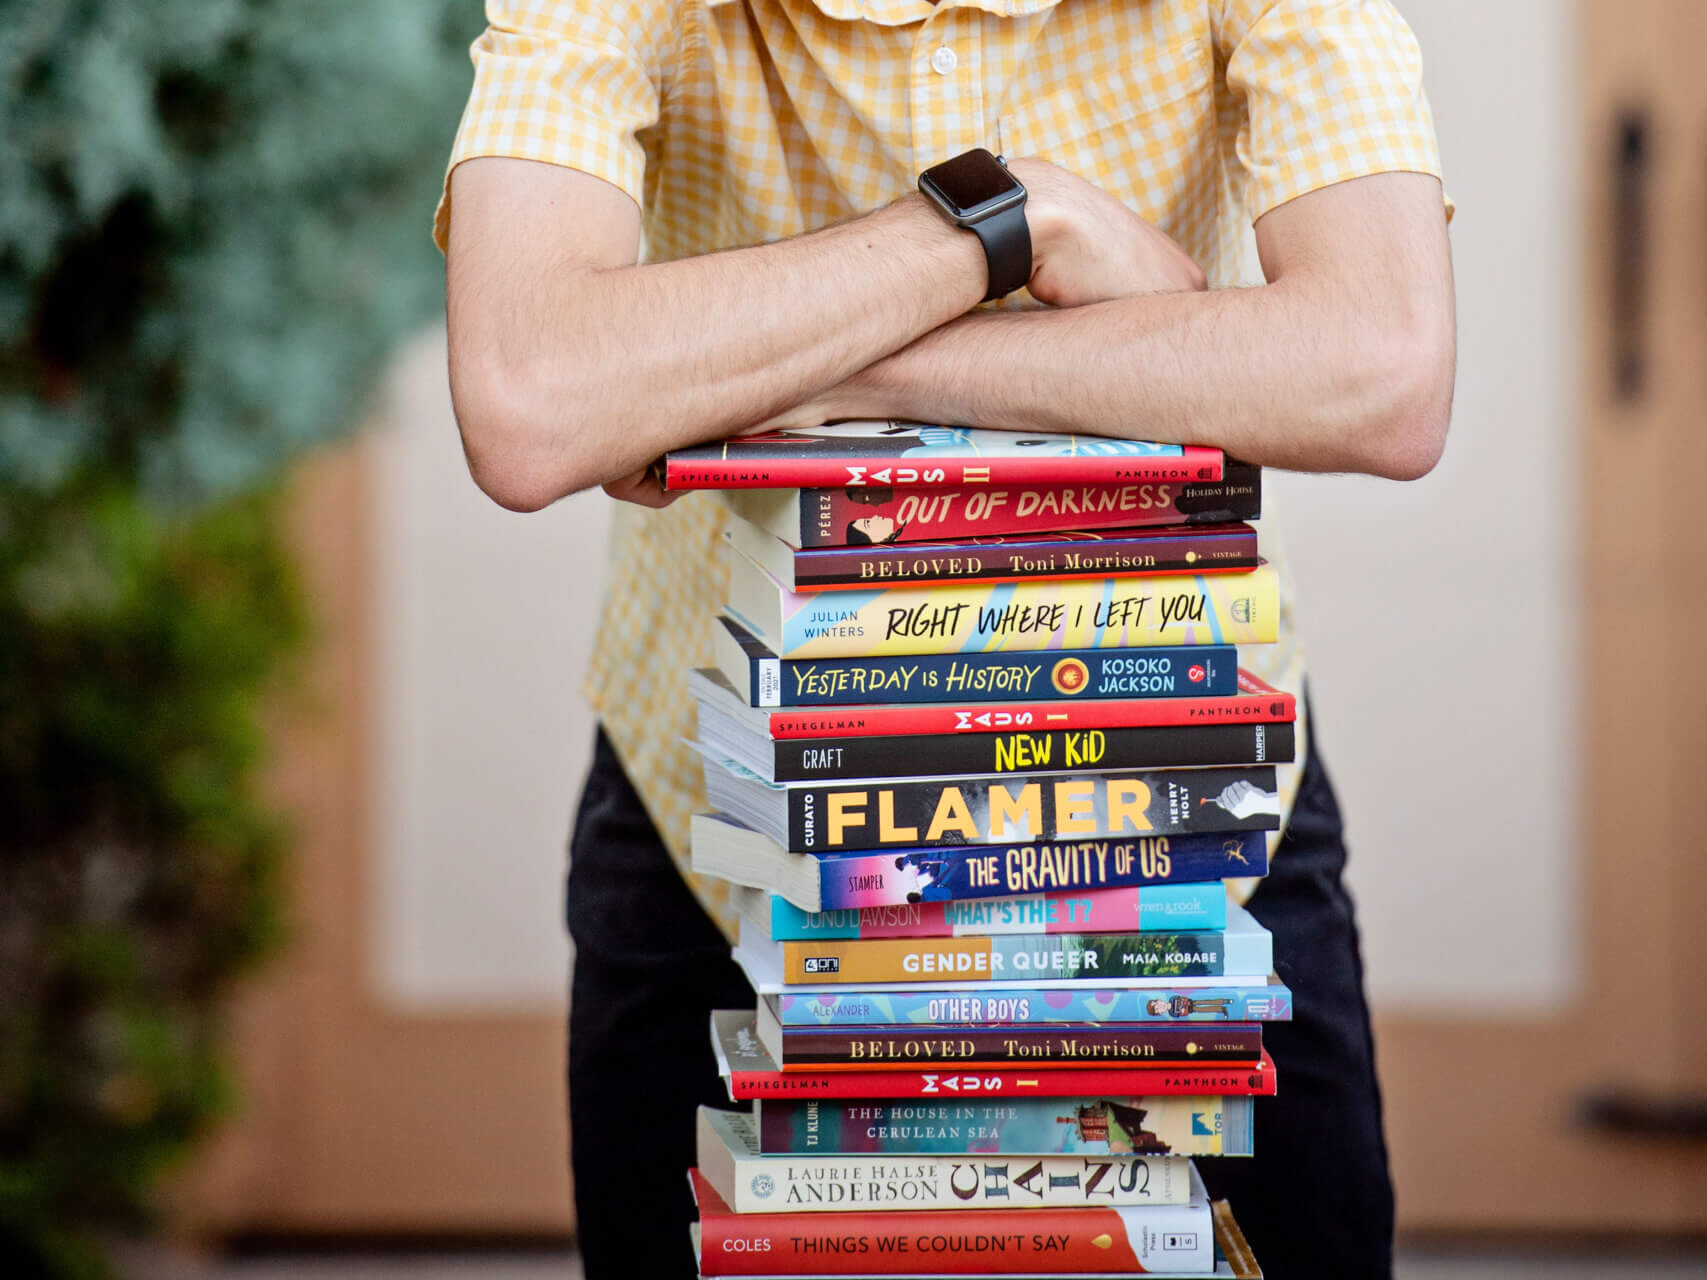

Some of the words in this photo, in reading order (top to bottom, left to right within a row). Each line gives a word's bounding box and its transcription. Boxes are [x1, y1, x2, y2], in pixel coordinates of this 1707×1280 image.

[681, 472, 770, 483] SPIEGELMAN
[845, 466, 945, 486] MAUS
[1115, 470, 1189, 479] PANTHEON
[896, 492, 961, 525] OUT
[964, 491, 1008, 521] OF
[1016, 484, 1172, 517] DARKNESS
[820, 495, 831, 537] PÉREZ
[1009, 555, 1055, 571] Toni
[1064, 552, 1156, 570] Morrison
[1212, 551, 1242, 559] VINTAGE
[860, 558, 982, 578] BELOVED
[810, 611, 858, 623] JULIAN
[886, 603, 970, 640] RIGHT
[977, 603, 1066, 635] WHERE
[1075, 605, 1083, 628] I
[1093, 596, 1152, 628] LEFT
[1161, 594, 1205, 632] YOU
[804, 626, 864, 638] WINTERS
[1102, 659, 1171, 675] KOSOKO
[792, 665, 918, 696] YESTERDAY
[923, 671, 938, 687] IS
[946, 662, 1041, 693] HISTORY
[1099, 675, 1174, 693] JACKSON
[954, 711, 1033, 729] MAUS
[1190, 705, 1261, 717] PANTHEON
[779, 720, 865, 732] SPIEGELMAN
[995, 733, 1051, 772] NEW
[1256, 725, 1264, 762] HARPER
[803, 748, 843, 769] CRAFT
[1168, 782, 1179, 825] HENRY
[1181, 786, 1189, 819] HOLT
[804, 794, 814, 847] CURATO
[827, 779, 1154, 846] FLAMER
[966, 856, 1000, 887] THE
[1005, 843, 1108, 891] GRAVITY
[1115, 844, 1135, 875] OF
[1140, 838, 1172, 878] US
[849, 874, 884, 893] STAMPER
[851, 904, 921, 927] DAWSON
[943, 901, 1013, 926] WHAT'S
[1014, 899, 1058, 924] THE
[1065, 898, 1093, 923] T?
[903, 952, 1004, 972] GENDER
[1013, 950, 1099, 970] QUEER
[1123, 952, 1159, 965] MAIA
[1165, 951, 1217, 964] KOBABE
[813, 1003, 870, 1016] ALEXANDER
[929, 998, 983, 1020] OTHER
[987, 998, 1030, 1020] BOYS
[850, 1040, 976, 1058] BELOVED
[1004, 1040, 1050, 1057] Toni
[1060, 1039, 1155, 1057] Morrison
[741, 1080, 829, 1089] SPIEGELMAN
[921, 1074, 1002, 1093] MAUS
[1165, 1078, 1238, 1087] PANTHEON
[808, 1101, 818, 1133] KLUNE
[848, 1107, 884, 1119] THE
[891, 1107, 948, 1119] HOUSE
[955, 1107, 975, 1119] IN
[983, 1106, 1018, 1119] THE
[866, 1127, 961, 1138] CERULEAN
[968, 1127, 999, 1138] SEA
[1215, 1113, 1223, 1135] TOR
[808, 1134, 818, 1146] TJ
[787, 1167, 862, 1180] LAURIE
[871, 1165, 938, 1178] HALSE
[951, 1157, 1150, 1200] CHAINS
[786, 1180, 939, 1203] ANDERSON
[723, 1238, 771, 1252] COLES
[791, 1237, 870, 1253] THINGS
[876, 1237, 909, 1253] WE
[916, 1235, 1025, 1252] COULDN'T
[1032, 1235, 1070, 1251] SAY
